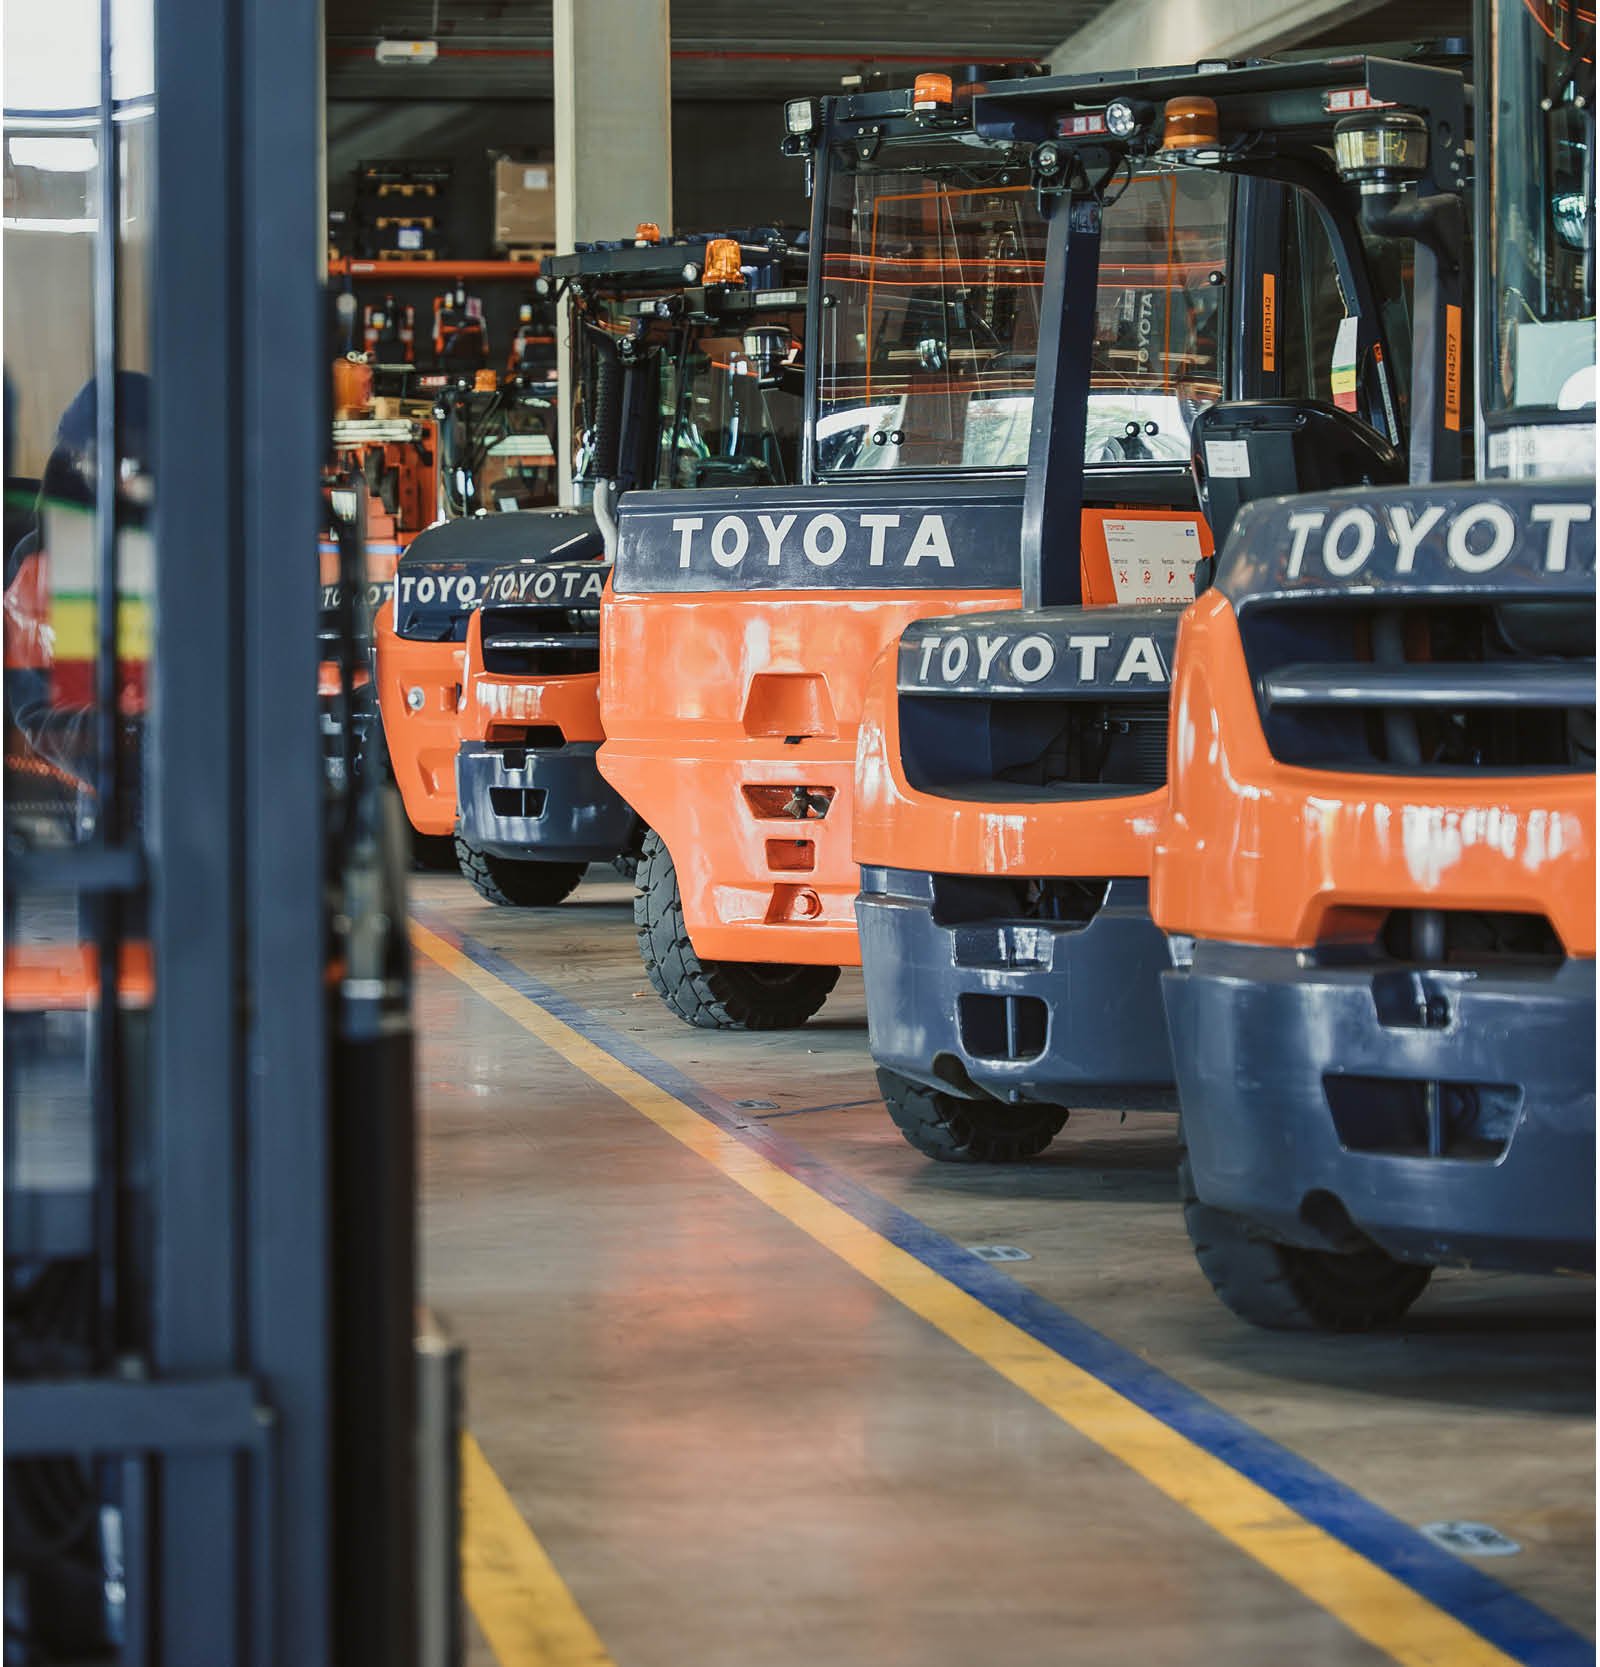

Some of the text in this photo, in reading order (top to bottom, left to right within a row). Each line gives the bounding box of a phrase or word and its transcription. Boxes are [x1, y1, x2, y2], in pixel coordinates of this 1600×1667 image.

[1137, 292, 1152, 374] TOYOTA
[672, 513, 955, 568] TOYOTA
[1287, 503, 1592, 578] TOYOT
[401, 575, 488, 603] TOYO
[490, 572, 602, 600] TOYOTA
[919, 635, 1166, 683] TOYOTA
